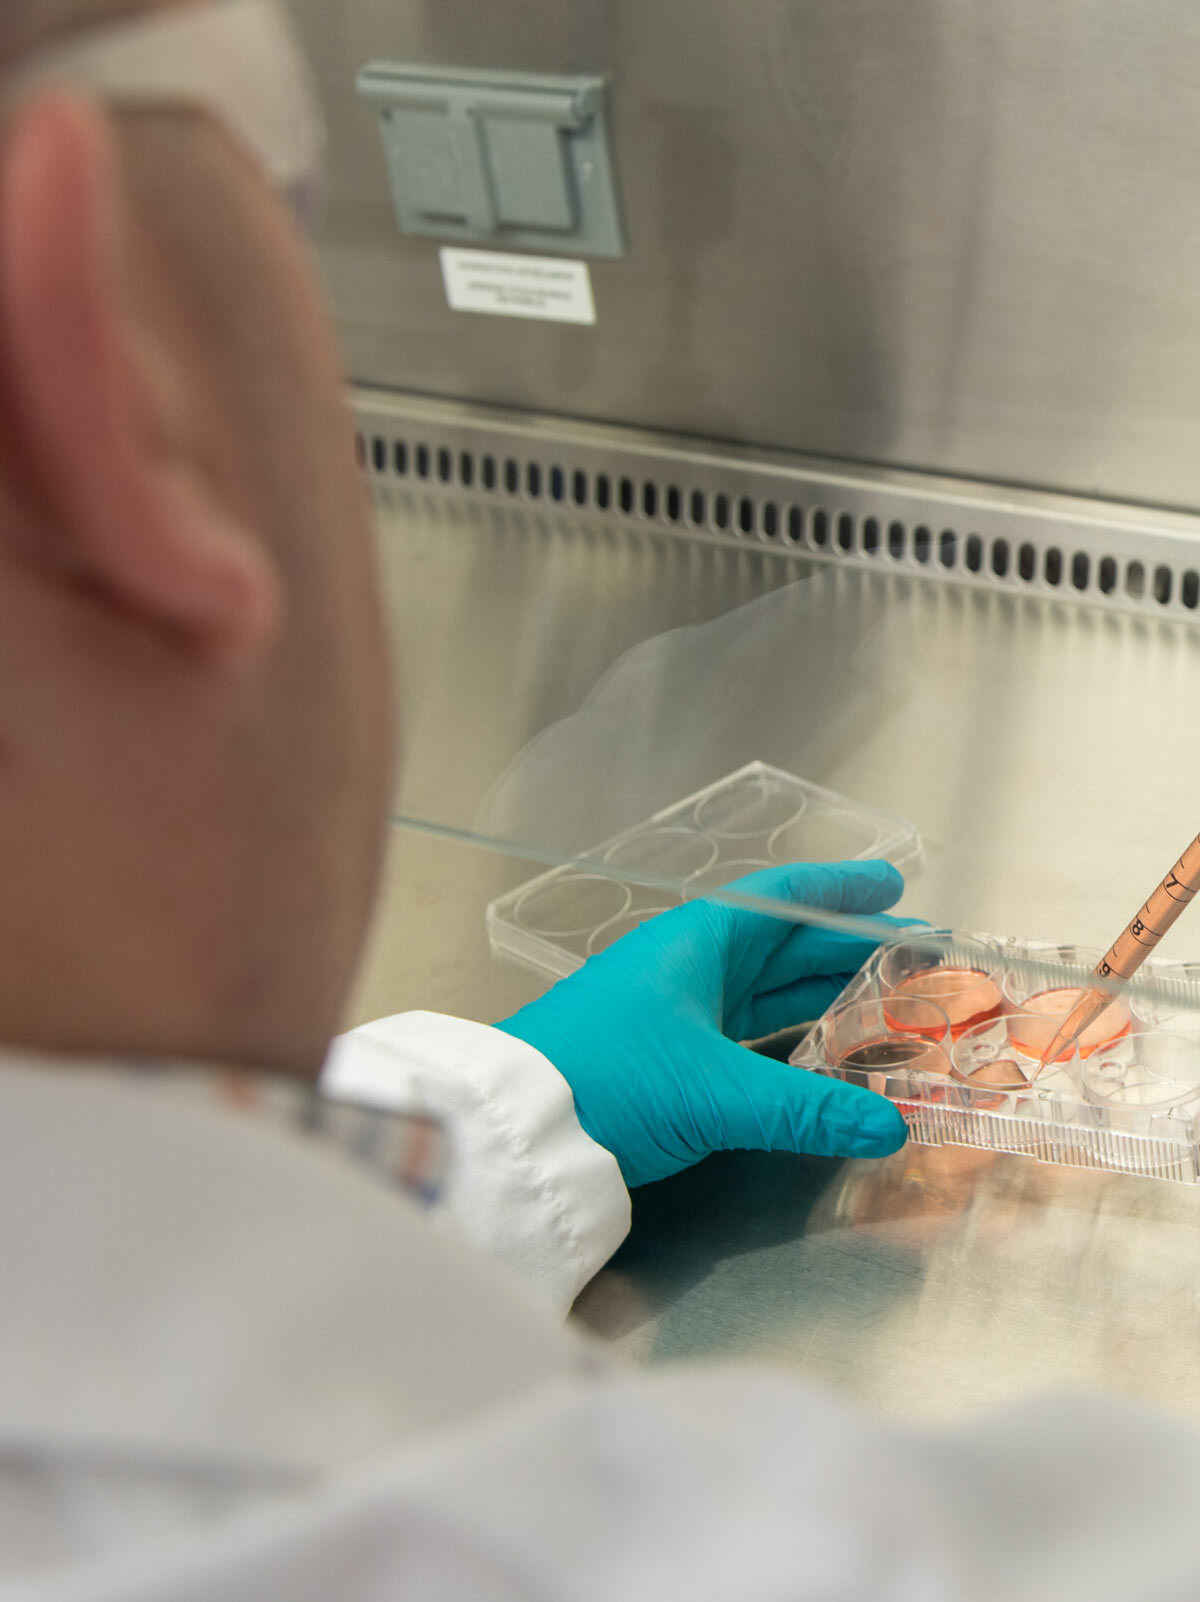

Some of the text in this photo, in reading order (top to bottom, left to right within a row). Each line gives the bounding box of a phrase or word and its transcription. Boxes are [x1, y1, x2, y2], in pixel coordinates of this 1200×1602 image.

[1166, 872, 1179, 889] 7
[1132, 919, 1145, 936] 8
[1101, 963, 1111, 978] 9
